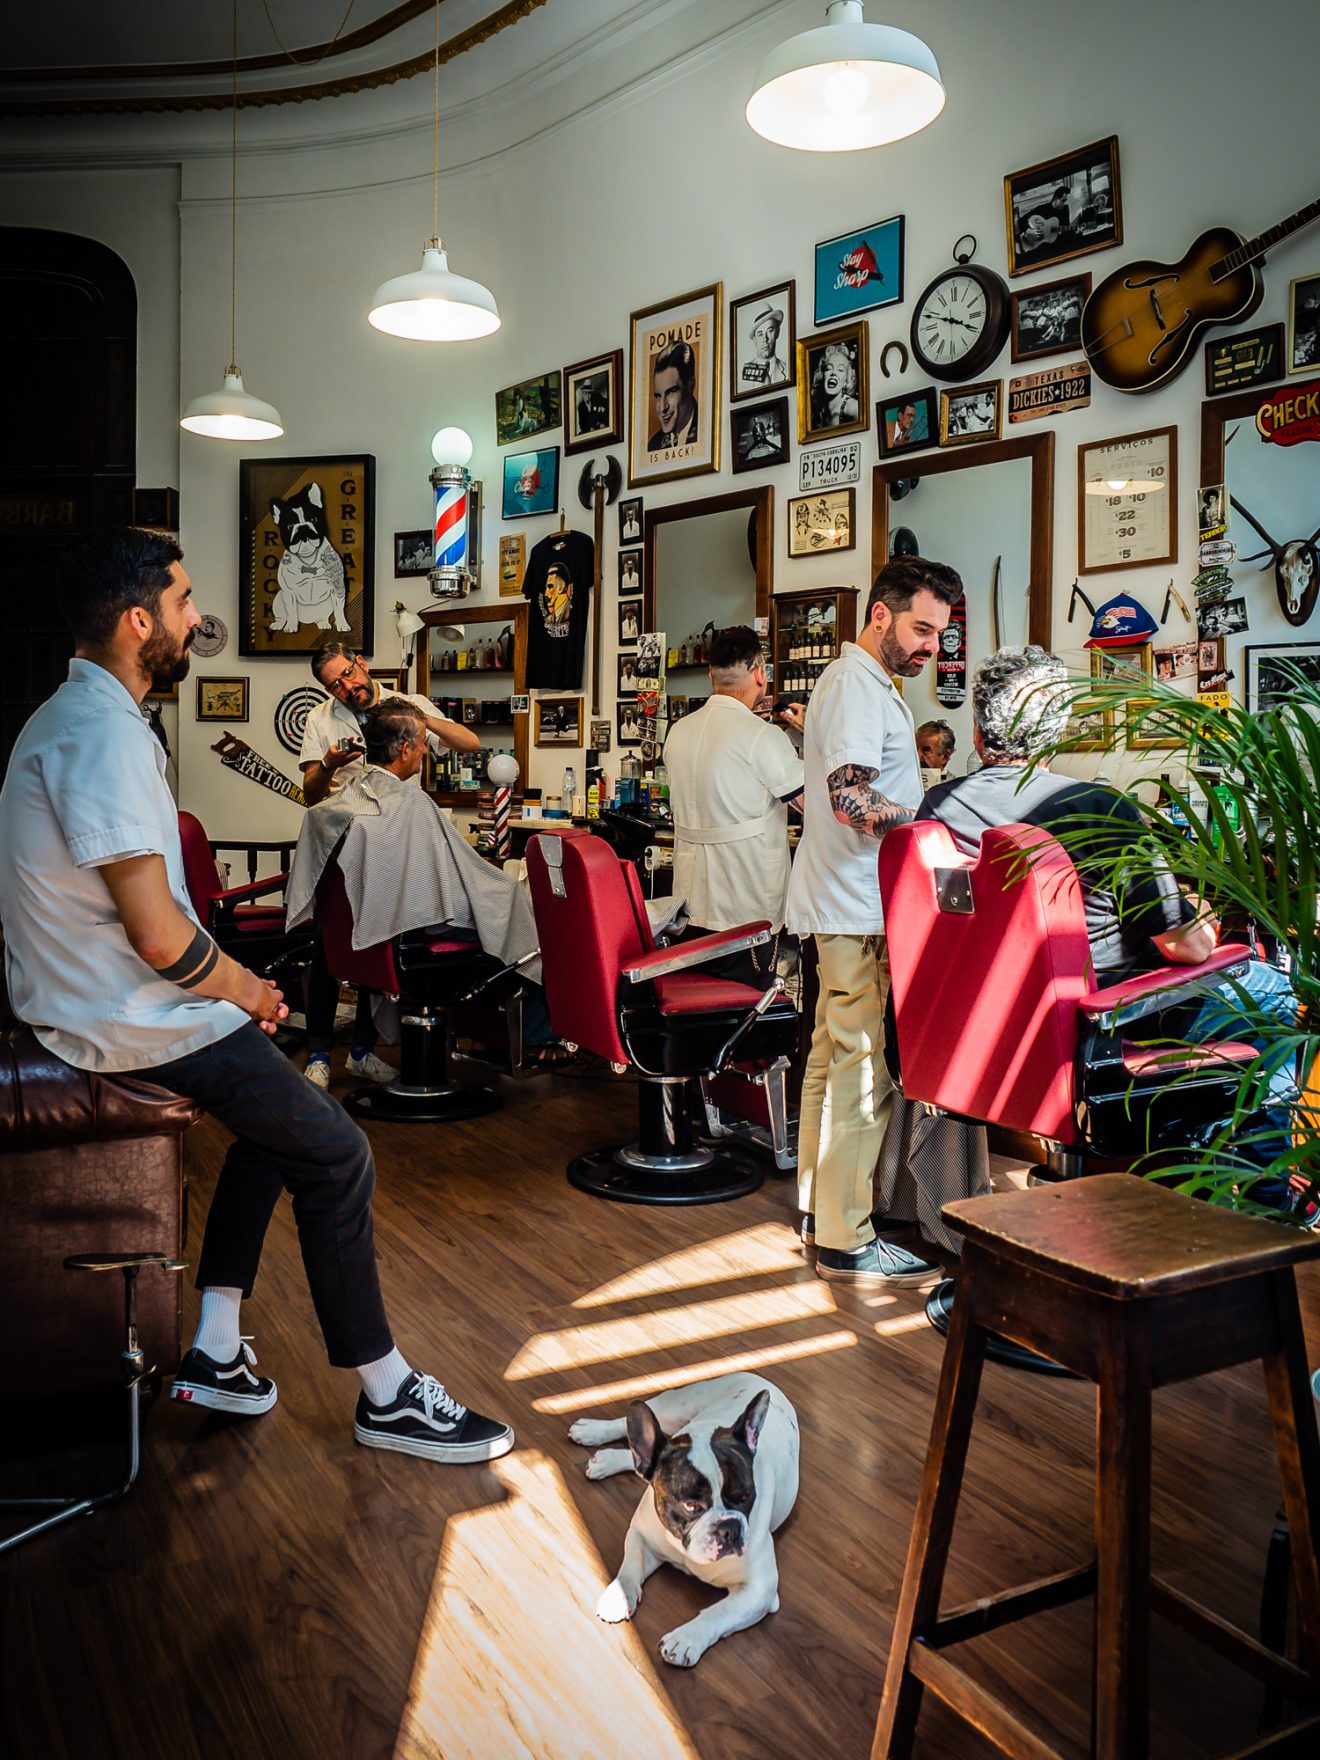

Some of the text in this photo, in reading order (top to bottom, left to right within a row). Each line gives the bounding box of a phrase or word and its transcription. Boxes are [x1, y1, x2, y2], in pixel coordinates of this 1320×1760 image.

[840, 252, 864, 269] Stay
[833, 269, 869, 290] Sharp
[649, 321, 701, 350] POMADE
[1035, 371, 1064, 385] TEXAS
[1013, 378, 1085, 410] DICKIES 1922
[650, 453, 658, 463] IS
[665, 446, 694, 460] BACK!
[802, 453, 856, 480] P134095
[820, 477, 839, 485] TRUCK
[340, 479, 357, 595] GREAT
[238, 756, 292, 795] TATTOO
